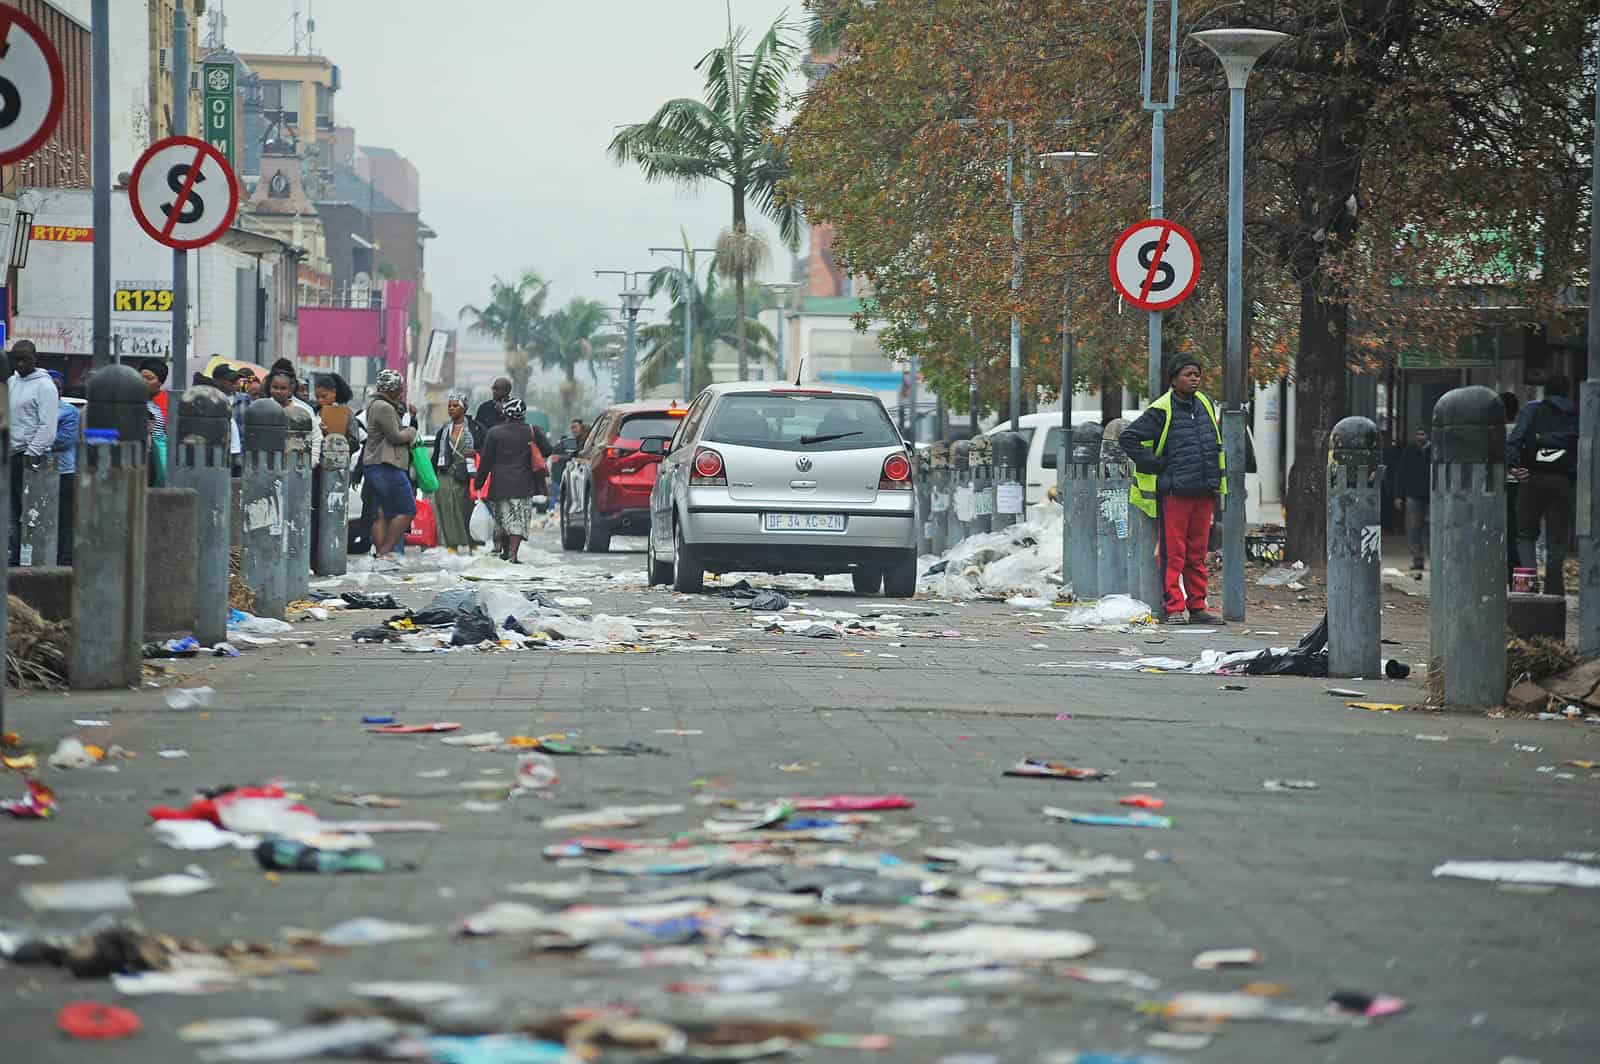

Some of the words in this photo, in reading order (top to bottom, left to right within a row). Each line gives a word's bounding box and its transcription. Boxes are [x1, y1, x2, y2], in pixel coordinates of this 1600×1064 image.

[160, 164, 206, 224] S
[1138, 241, 1175, 291] S
[114, 289, 175, 311] R129
